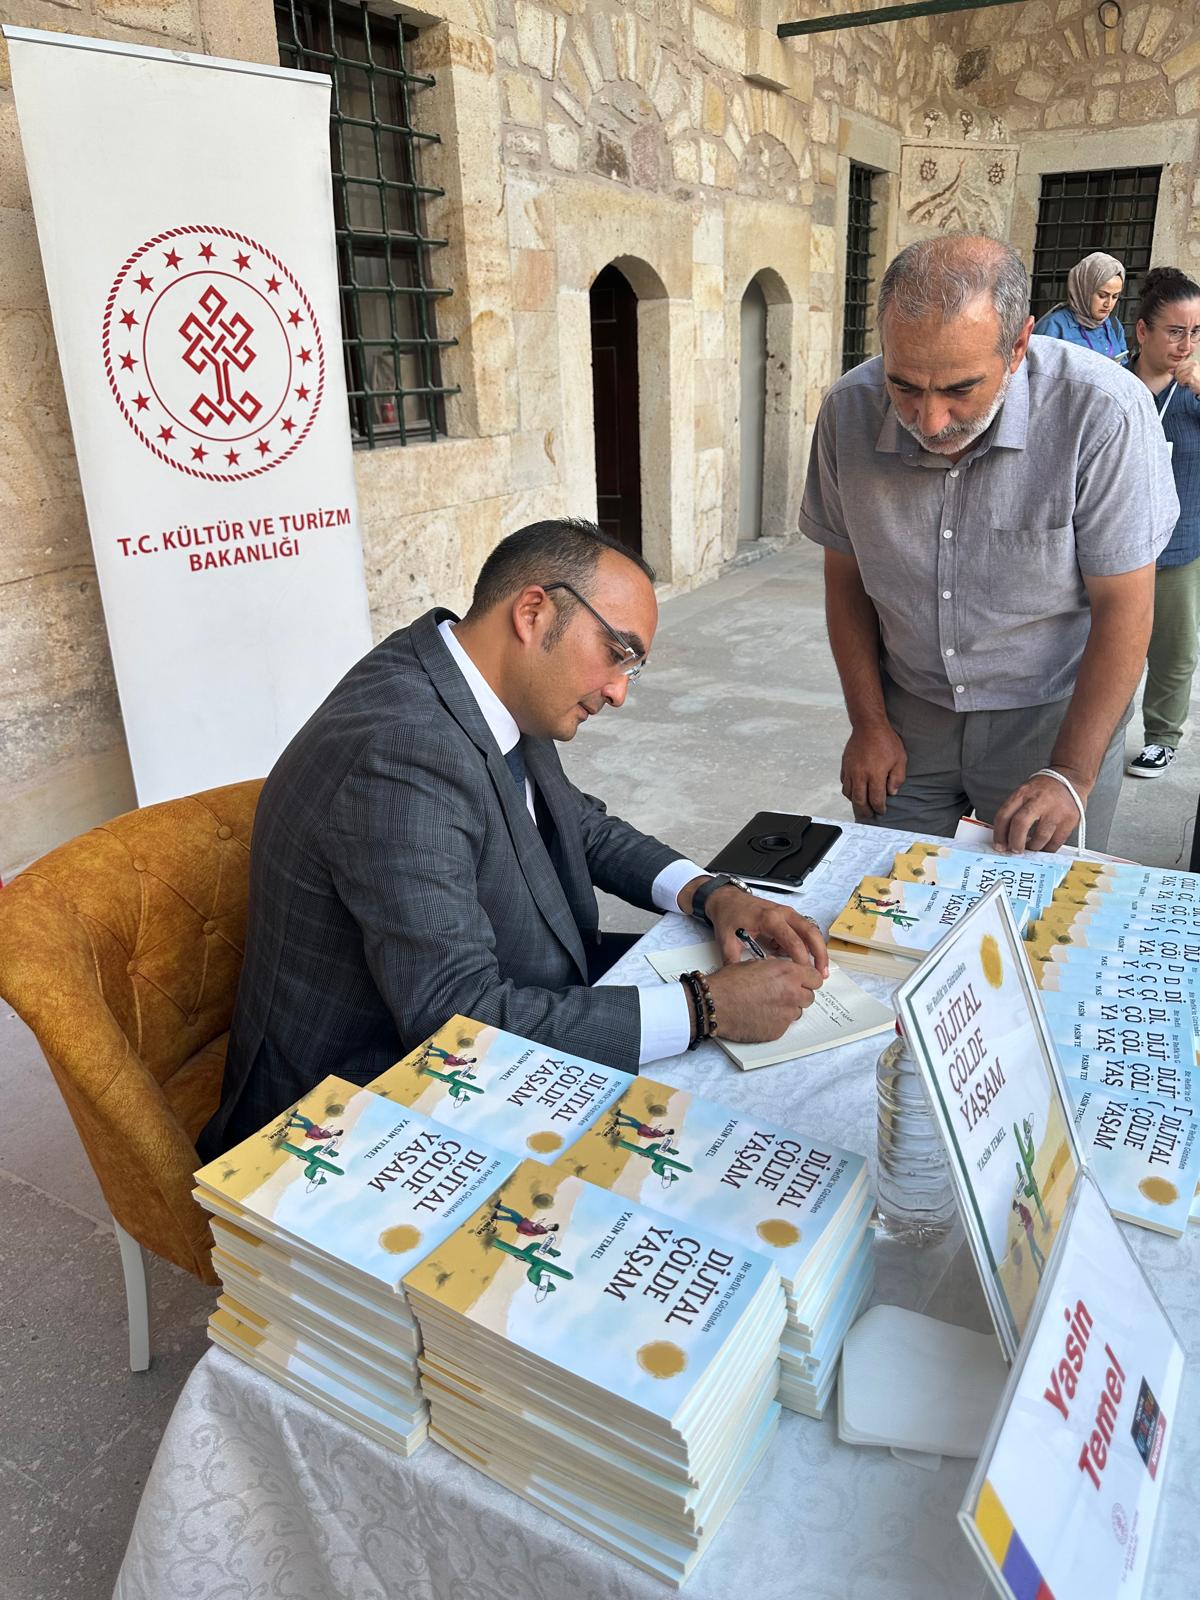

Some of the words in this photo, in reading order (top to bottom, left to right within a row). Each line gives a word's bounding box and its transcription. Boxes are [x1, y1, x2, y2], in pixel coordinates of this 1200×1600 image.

[117, 535, 158, 557] T.C.
[162, 519, 245, 551] KÜLTÜR
[248, 519, 275, 538] VE
[279, 508, 351, 534] TURİZM
[188, 538, 300, 573] BAKANLIĞI
[976, 868, 997, 893] YAŞ
[1017, 872, 1037, 900] DİJİT
[939, 894, 967, 926] YAŞAM
[934, 982, 982, 1056] DİJİTAL
[1093, 1027, 1116, 1054] YAŞ
[516, 1048, 535, 1065] YASİN
[948, 1027, 988, 1100] ÇÖLDE
[1118, 1029, 1144, 1055] ÇÖL
[1147, 1032, 1170, 1061] DİJİ
[499, 1064, 520, 1081] TEMEL
[506, 1058, 565, 1107] YAŞAM
[536, 1065, 585, 1108] ÇÖLDE
[1100, 1060, 1125, 1087] YAŞ
[1127, 1063, 1154, 1094] ÇÖL
[1157, 1066, 1181, 1099] DİJİ
[550, 1072, 609, 1121] DİJİTAL
[959, 1057, 1006, 1133] YAŞAM
[387, 1119, 411, 1139] YASİN
[720, 1119, 739, 1140] YASİN
[1093, 1100, 1128, 1150] YAŞAM
[1123, 1107, 1157, 1150] ÇÖLDE
[1148, 1114, 1185, 1165] DİJİTAL
[364, 1138, 391, 1160] TEMEL
[367, 1131, 442, 1193] YAŞAM
[400, 1140, 462, 1195] ÇÖLDE
[705, 1138, 725, 1157] TEMEL
[720, 1130, 776, 1189] YAŞAM
[754, 1139, 802, 1191] ÇÖLDE
[976, 1147, 994, 1173] YASİN
[990, 1126, 1007, 1152] TEMEL
[413, 1149, 488, 1212] DİJİTAL
[776, 1148, 832, 1208] DİJİTAL
[611, 1211, 633, 1235] YASİN
[591, 1233, 616, 1260] TEMEL
[603, 1226, 674, 1301] YAŞAM
[741, 1261, 753, 1273] Bir
[643, 1237, 701, 1304] ÇÖLDE
[664, 1248, 734, 1326] DİJİTAL
[1043, 1299, 1093, 1421] Yasin
[1078, 1343, 1126, 1491] Temel
